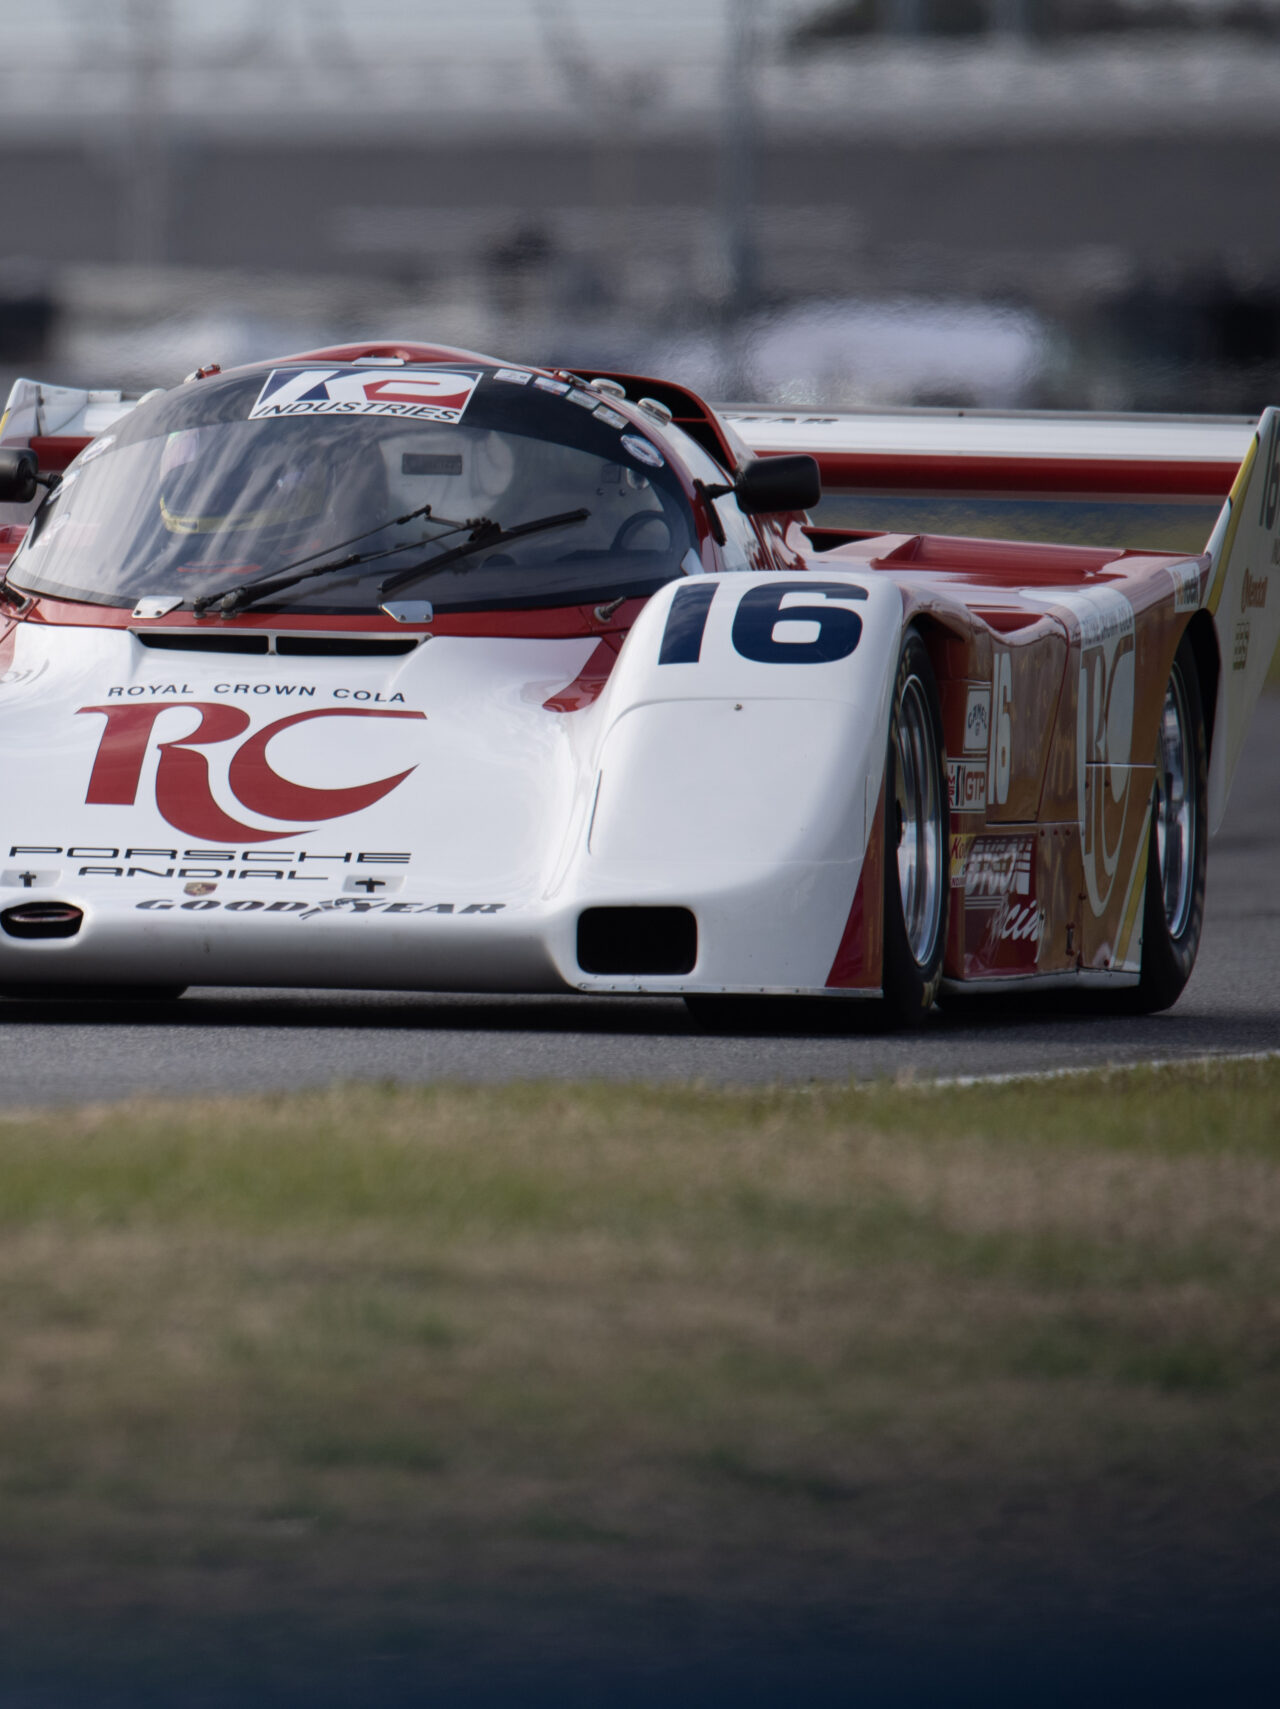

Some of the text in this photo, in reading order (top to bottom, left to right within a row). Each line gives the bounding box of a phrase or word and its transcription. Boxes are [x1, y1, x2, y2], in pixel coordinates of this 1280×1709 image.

[254, 401, 461, 421] INDUSTRIES
[658, 581, 869, 665] 16
[107, 683, 406, 703] ROYAL CROWN COLA
[967, 703, 988, 730] CAMEL
[987, 652, 1012, 805] 16
[74, 701, 428, 844] RC
[965, 770, 986, 801] GTP
[9, 846, 412, 864] PORSCHE
[78, 866, 329, 880] ANDIAL
[135, 898, 508, 916] GOODYEAR
